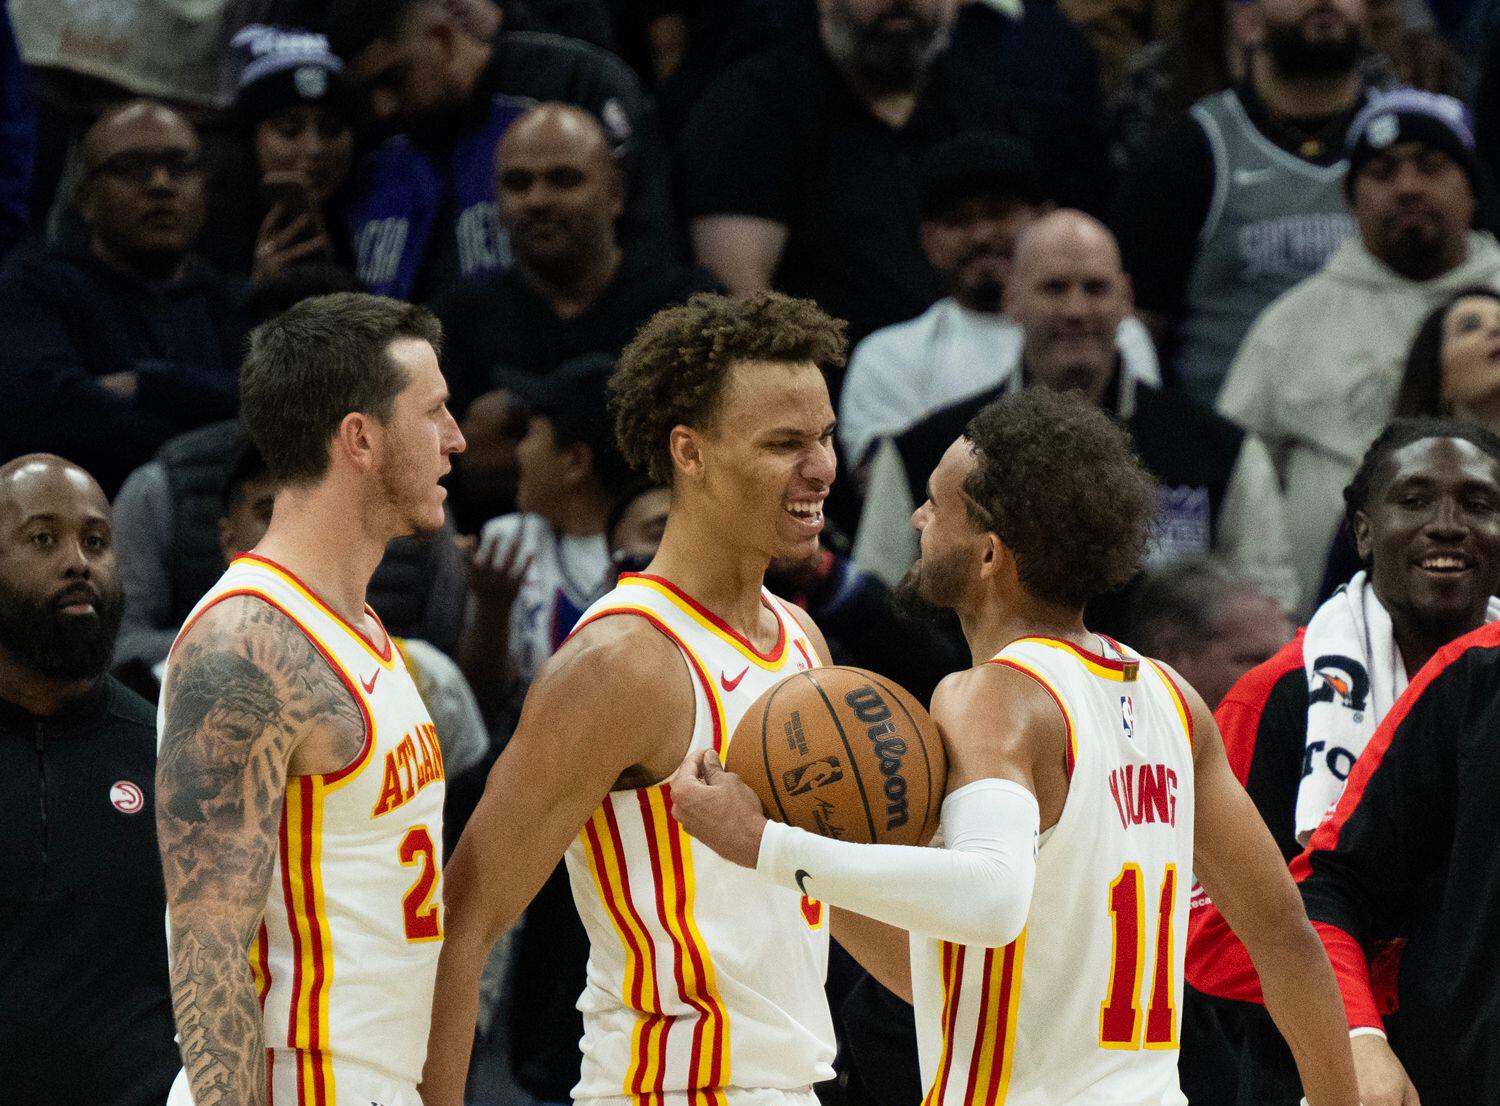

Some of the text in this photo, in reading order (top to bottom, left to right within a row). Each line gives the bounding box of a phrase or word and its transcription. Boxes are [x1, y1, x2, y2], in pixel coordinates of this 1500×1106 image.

[845, 683, 910, 832] Wilson
[397, 823, 445, 944] 2
[1099, 861, 1181, 1051] 11
